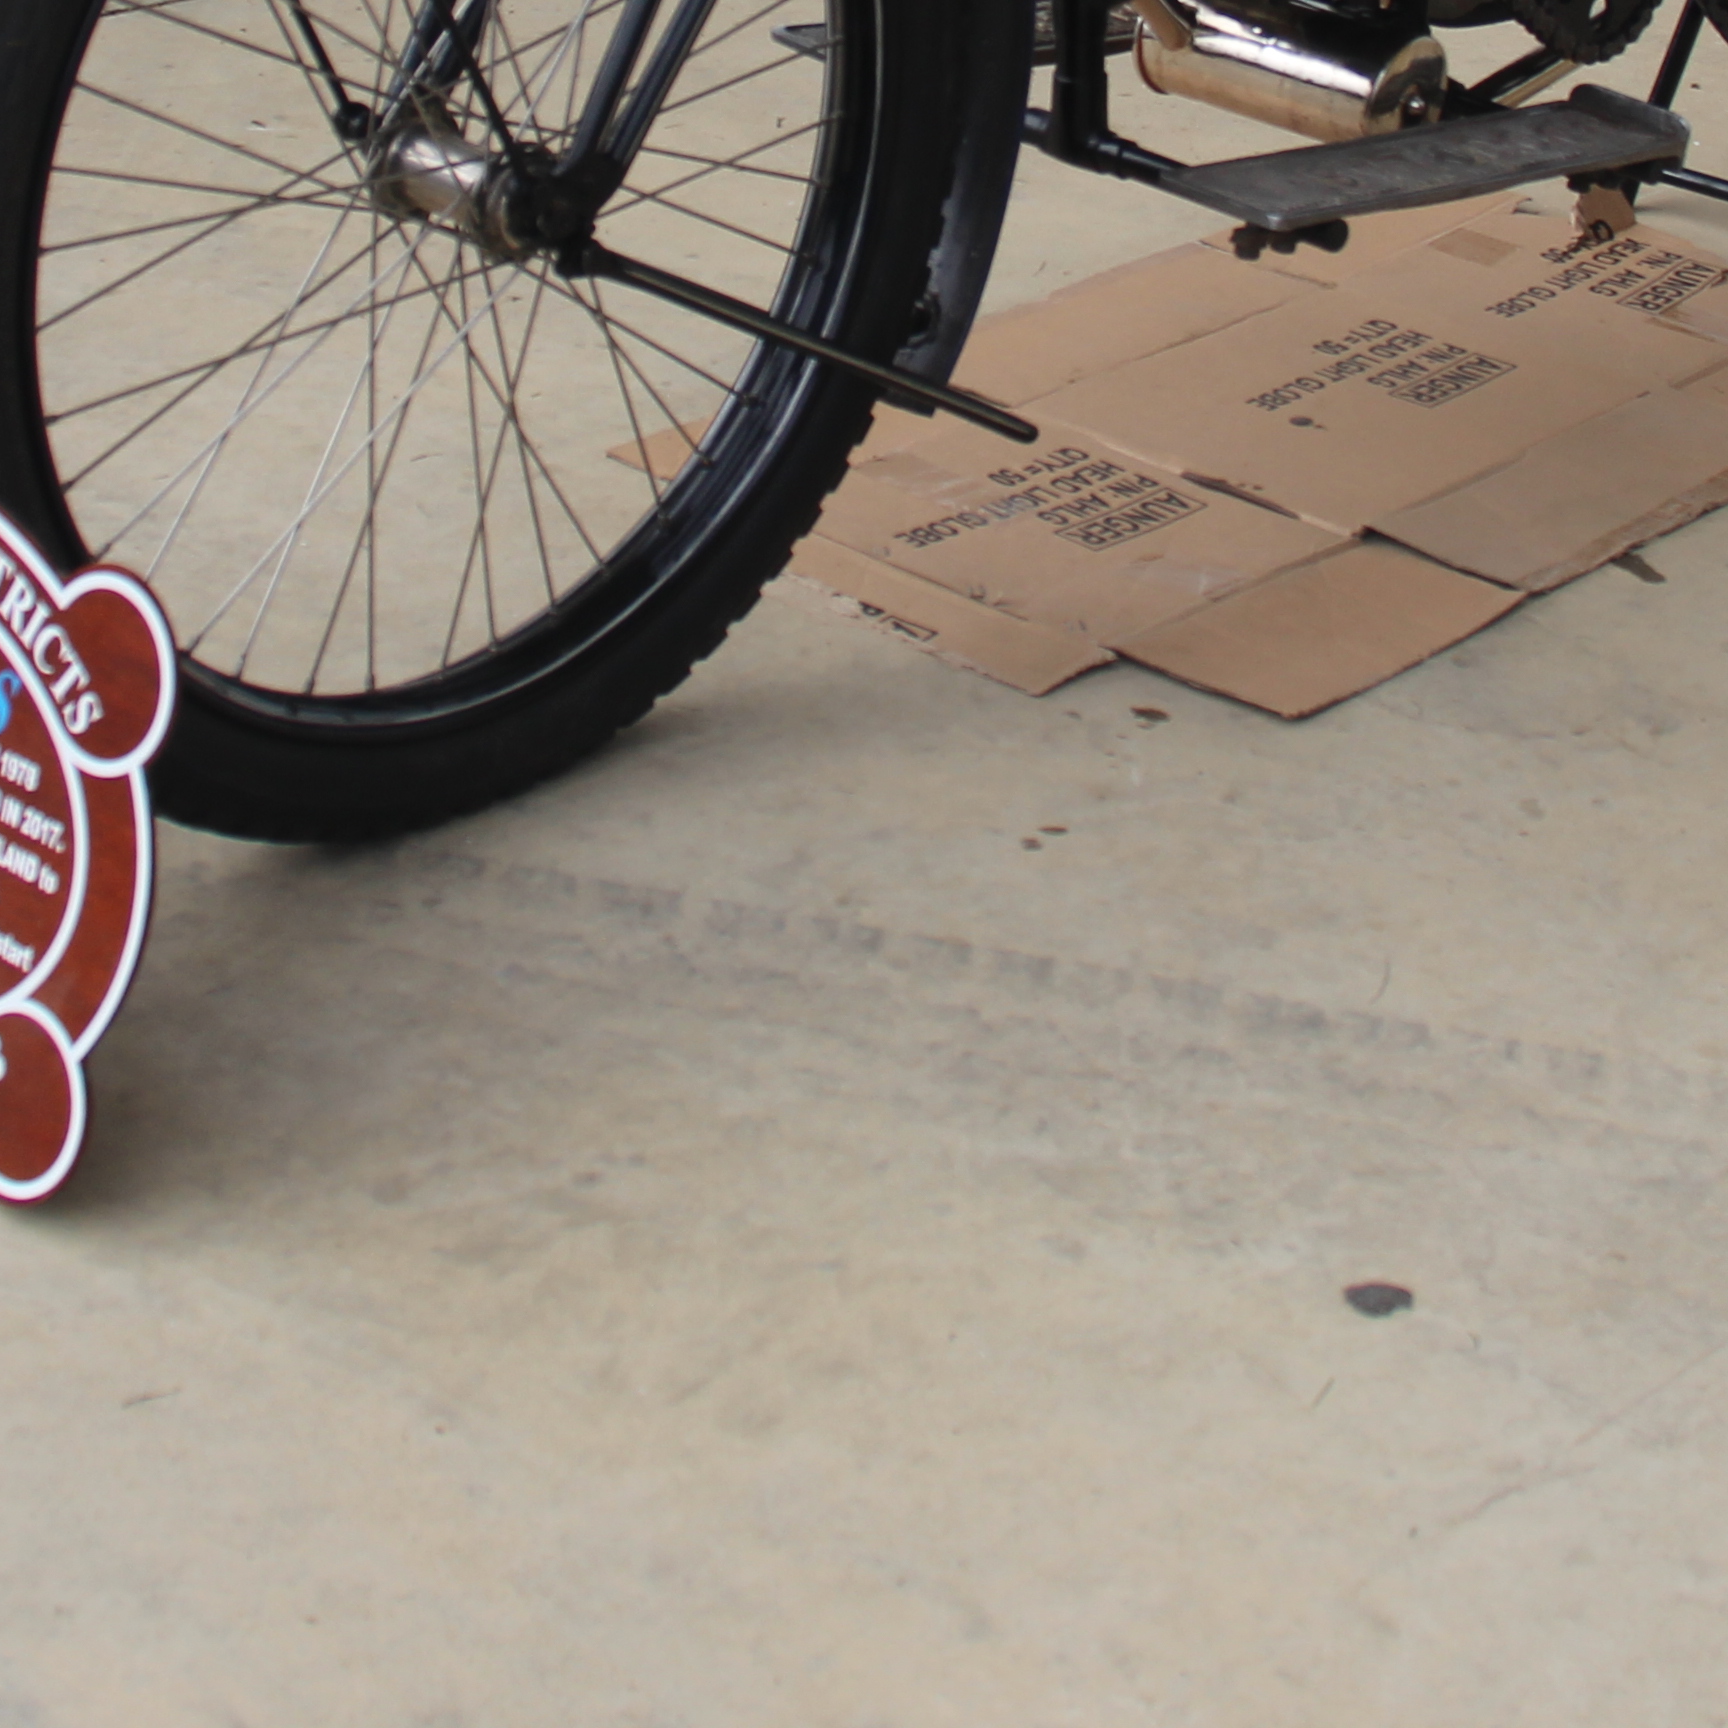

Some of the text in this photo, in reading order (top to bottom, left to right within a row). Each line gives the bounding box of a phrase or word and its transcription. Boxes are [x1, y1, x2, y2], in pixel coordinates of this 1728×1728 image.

[1484, 237, 1652, 318] HEAD LIGHT GLOBE
[1589, 268, 1647, 298] AHLG
[1625, 262, 1717, 312] AUNGER
[1245, 329, 1434, 413] HEAD LIGHT GLOBE
[1366, 359, 1429, 389] AHLG
[1399, 356, 1503, 404] AUNGER
[987, 468, 1029, 488] 50
[893, 459, 1126, 549] HEAD LIGHT GLOBE
[1037, 493, 1111, 526] AHLG
[1070, 492, 1191, 547] AUNGER
[0, 793, 25, 829] IN
[38, 862, 61, 895] to
